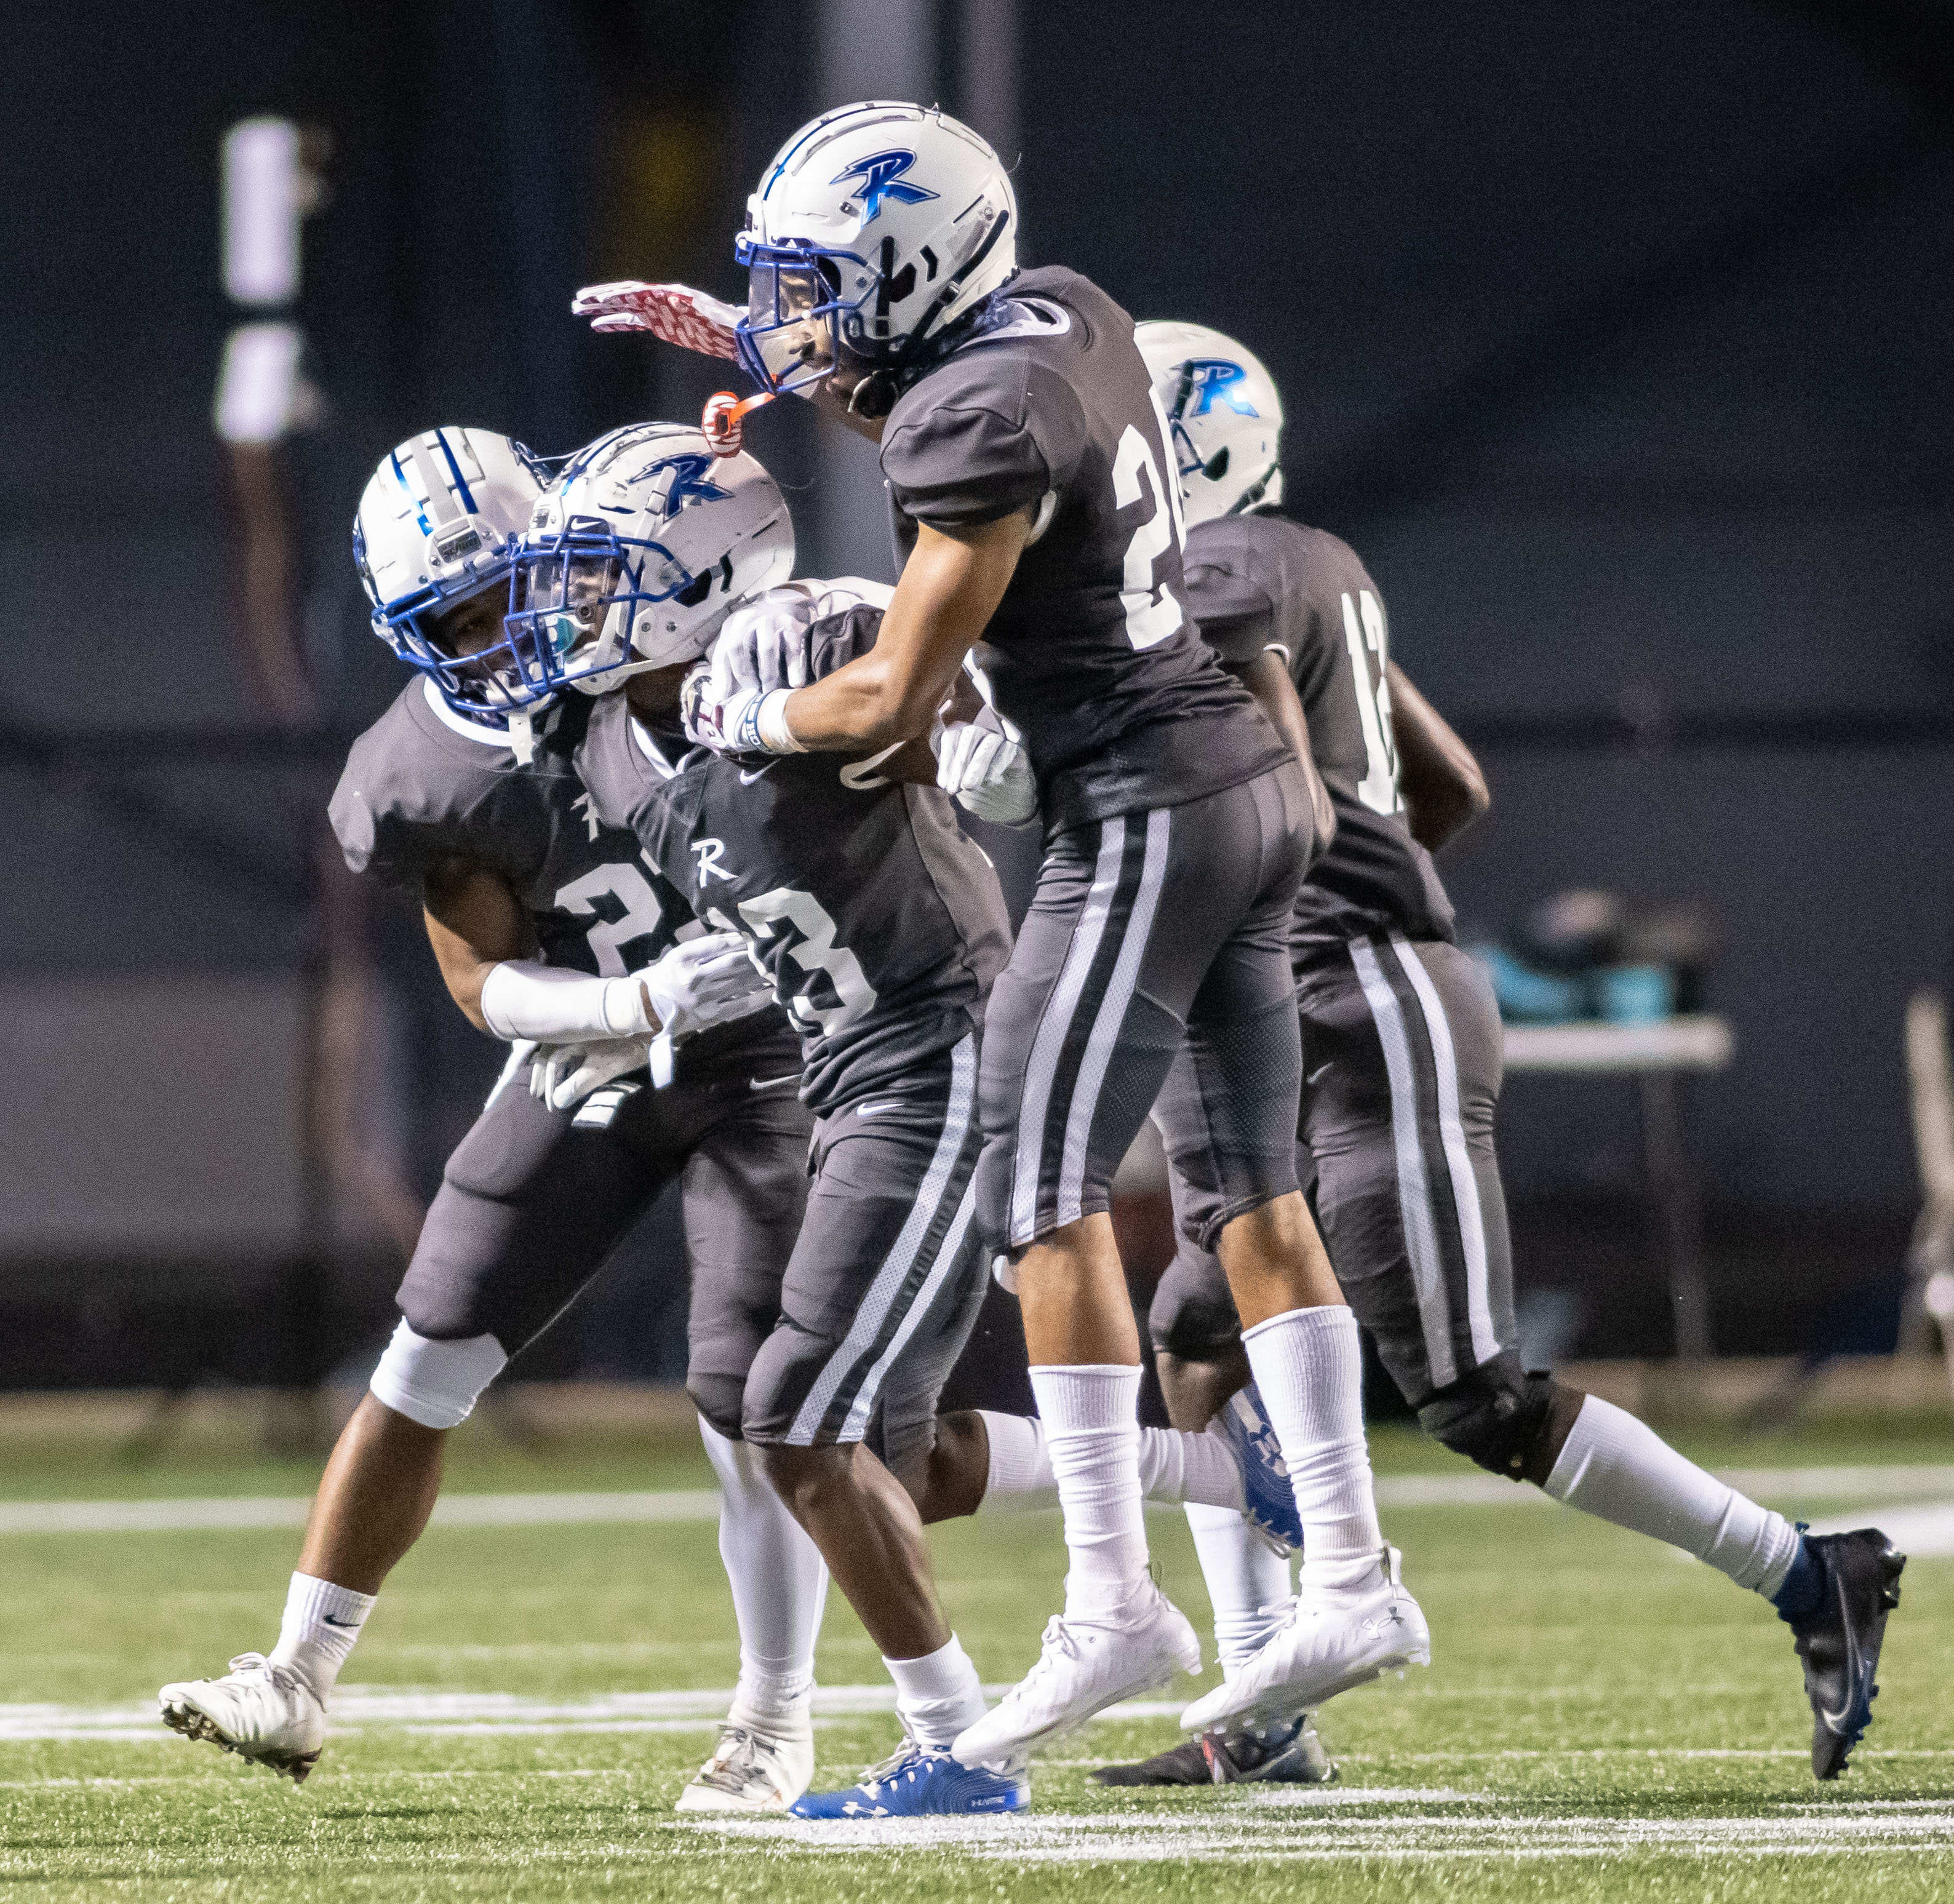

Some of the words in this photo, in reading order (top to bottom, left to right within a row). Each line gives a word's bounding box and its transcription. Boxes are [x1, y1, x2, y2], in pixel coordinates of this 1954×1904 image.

[829, 148, 940, 228] R
[1170, 357, 1260, 418] R
[690, 838, 738, 888] R
[554, 846, 709, 979] 2
[707, 887, 877, 1037] 3
